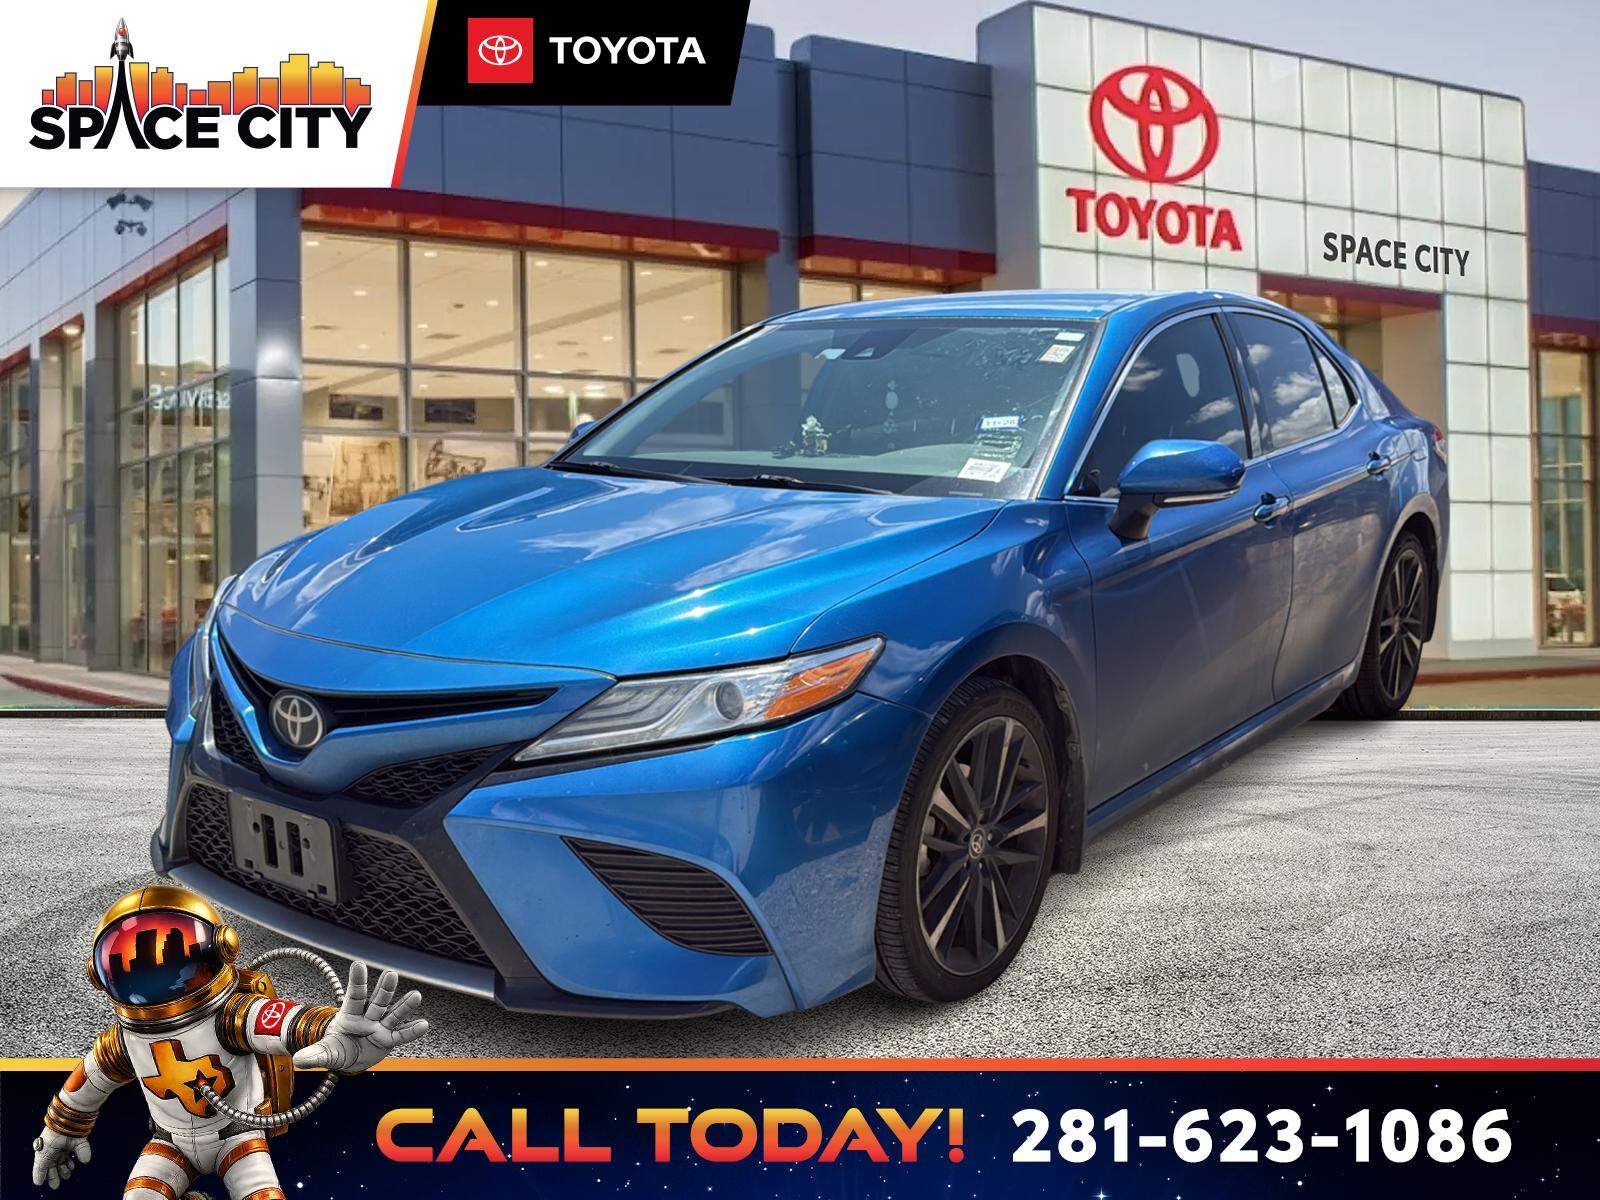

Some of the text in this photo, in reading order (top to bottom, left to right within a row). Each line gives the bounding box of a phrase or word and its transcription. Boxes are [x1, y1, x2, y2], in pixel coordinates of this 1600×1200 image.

[1066, 187, 1242, 252] TOYOTA
[1322, 232, 1471, 277] SPACE CITY
